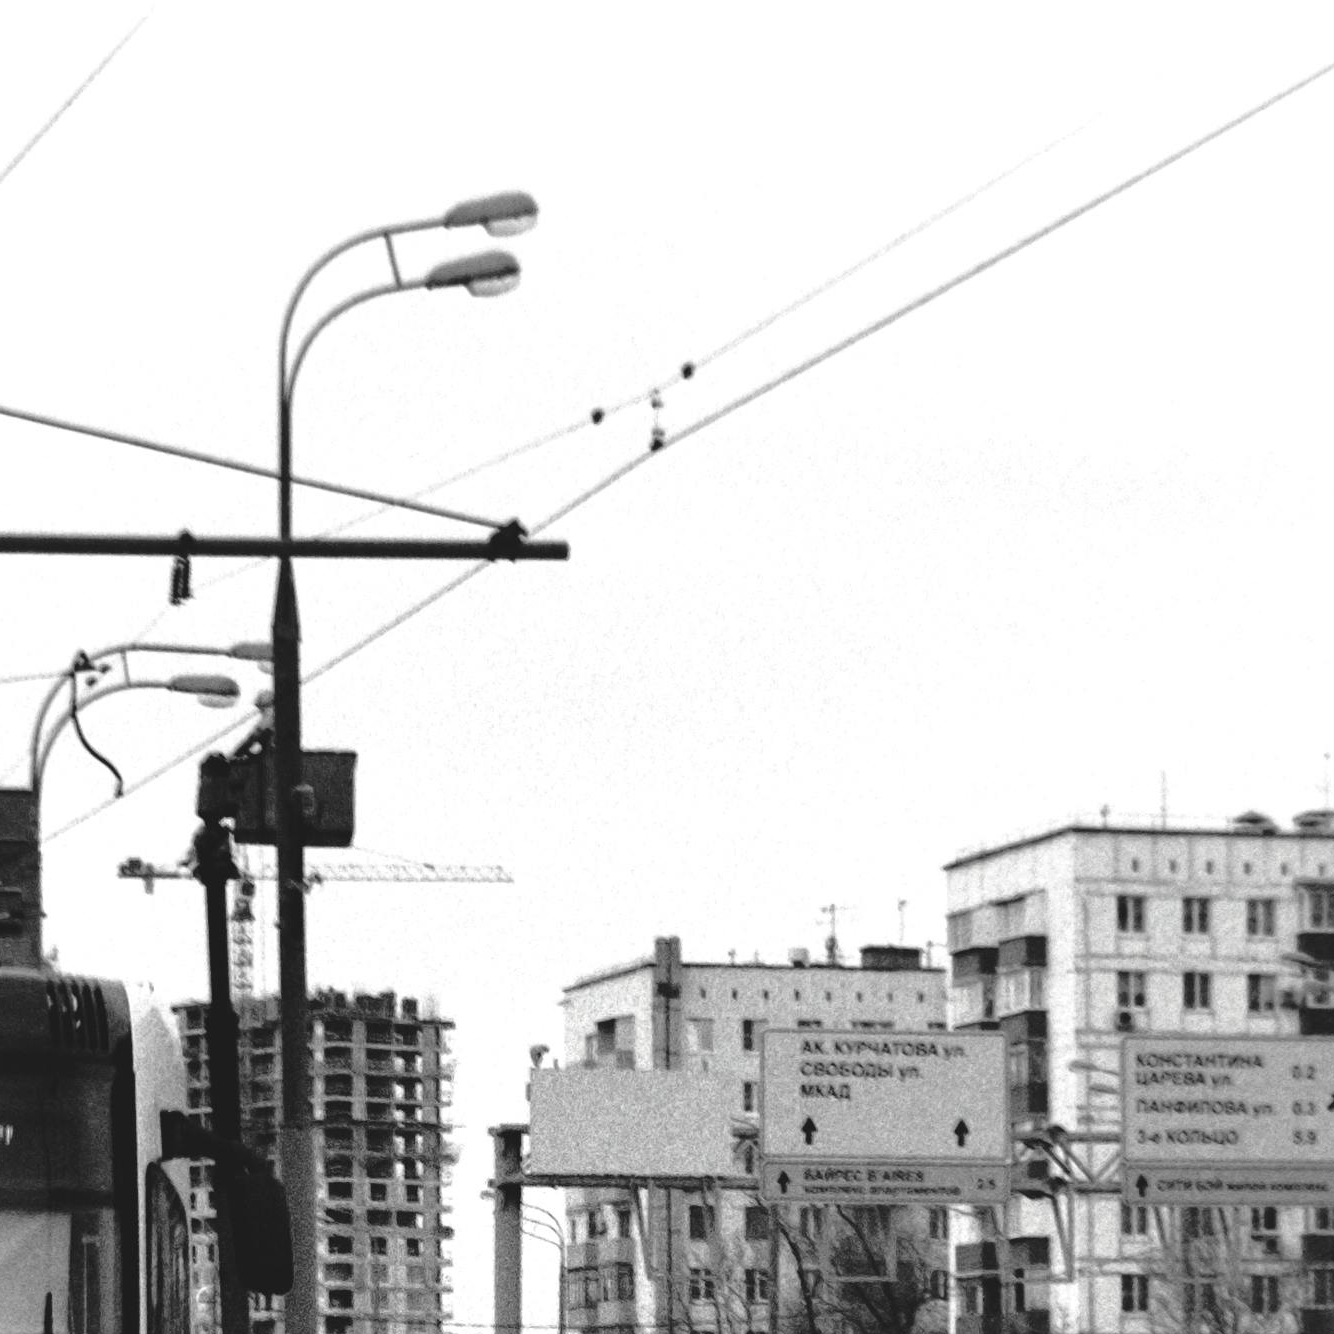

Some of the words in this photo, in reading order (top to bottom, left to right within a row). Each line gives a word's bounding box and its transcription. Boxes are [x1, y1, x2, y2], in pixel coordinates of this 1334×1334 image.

[833, 1040, 938, 1057] КУРЧАТОВА
[1135, 1053, 1264, 1068] КОНСТАНТИНА
[800, 1062, 893, 1079] СВОБОДЫ
[1135, 1071, 1207, 1087] ЦАРЕВА
[800, 1084, 851, 1101] МКАД
[1135, 1099, 1248, 1115] ПАНФИЛОВА
[1166, 1130, 1240, 1146] КОЛЬЦО
